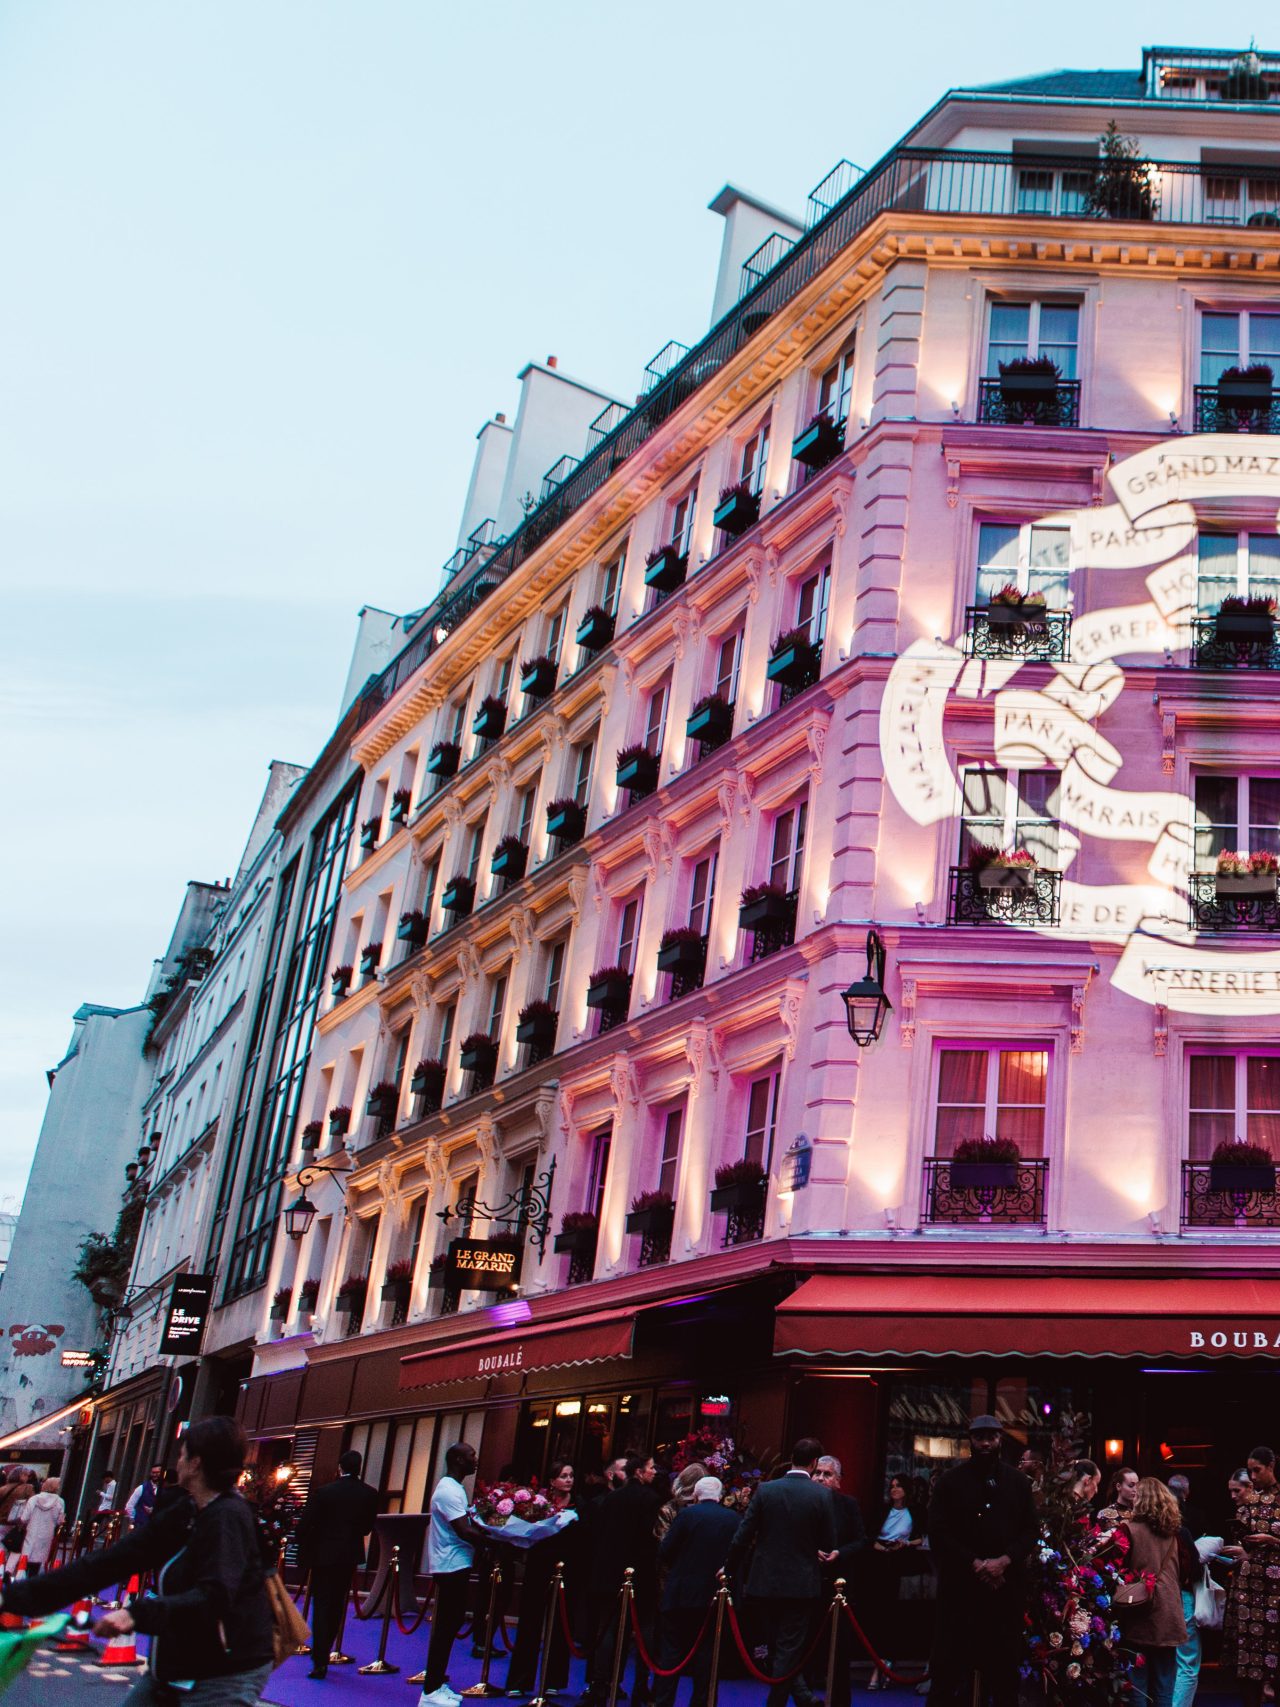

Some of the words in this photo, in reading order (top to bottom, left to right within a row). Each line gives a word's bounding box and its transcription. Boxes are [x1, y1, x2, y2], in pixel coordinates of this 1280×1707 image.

[1127, 456, 1219, 494] GRAND
[1065, 784, 1160, 827] MARAIS
[456, 1249, 471, 1260] LE
[474, 1250, 516, 1264] GRAND
[456, 1259, 514, 1273] MAZARIN
[173, 1308, 185, 1316] LE
[171, 1316, 201, 1325] DRIVE
[478, 1345, 523, 1372] BOUBALÉ
